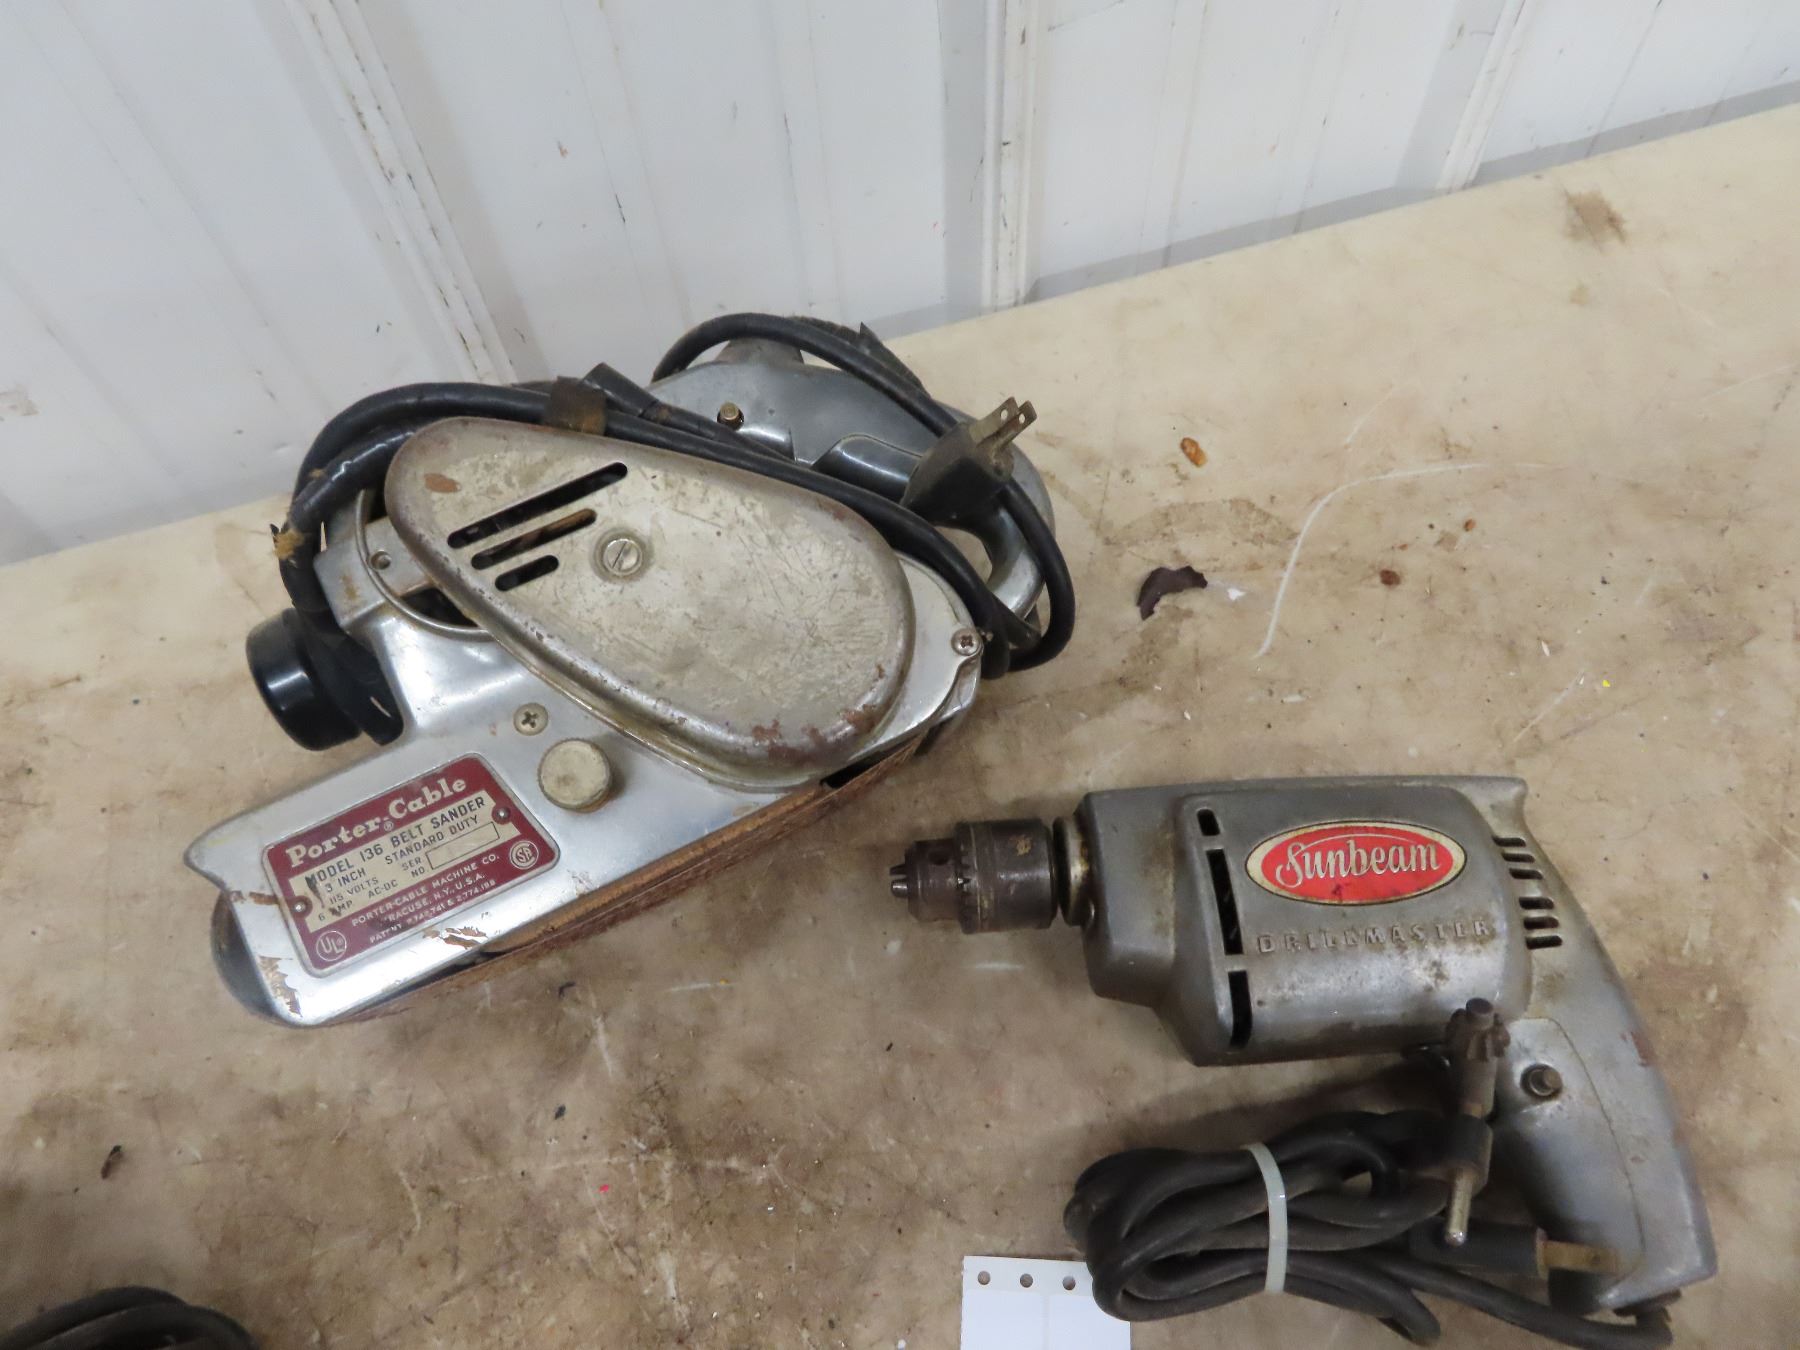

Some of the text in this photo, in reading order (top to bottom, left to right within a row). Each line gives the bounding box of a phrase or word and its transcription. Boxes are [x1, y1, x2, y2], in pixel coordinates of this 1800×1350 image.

[286, 778, 466, 867] Porter-Cable
[305, 796, 485, 889] MODEL 136 BELT SANDER
[384, 815, 479, 865] STANDARD DUTY
[324, 867, 366, 893] 3 INCH
[455, 872, 486, 890] U.S.A.
[1275, 834, 1441, 889] Sunbeam
[347, 877, 379, 895] VOLTS
[351, 854, 500, 926] PORTER-CABLE MACHINE CO.
[368, 879, 398, 898] AC-DC
[1257, 919, 1490, 953] DRILLMASTER
